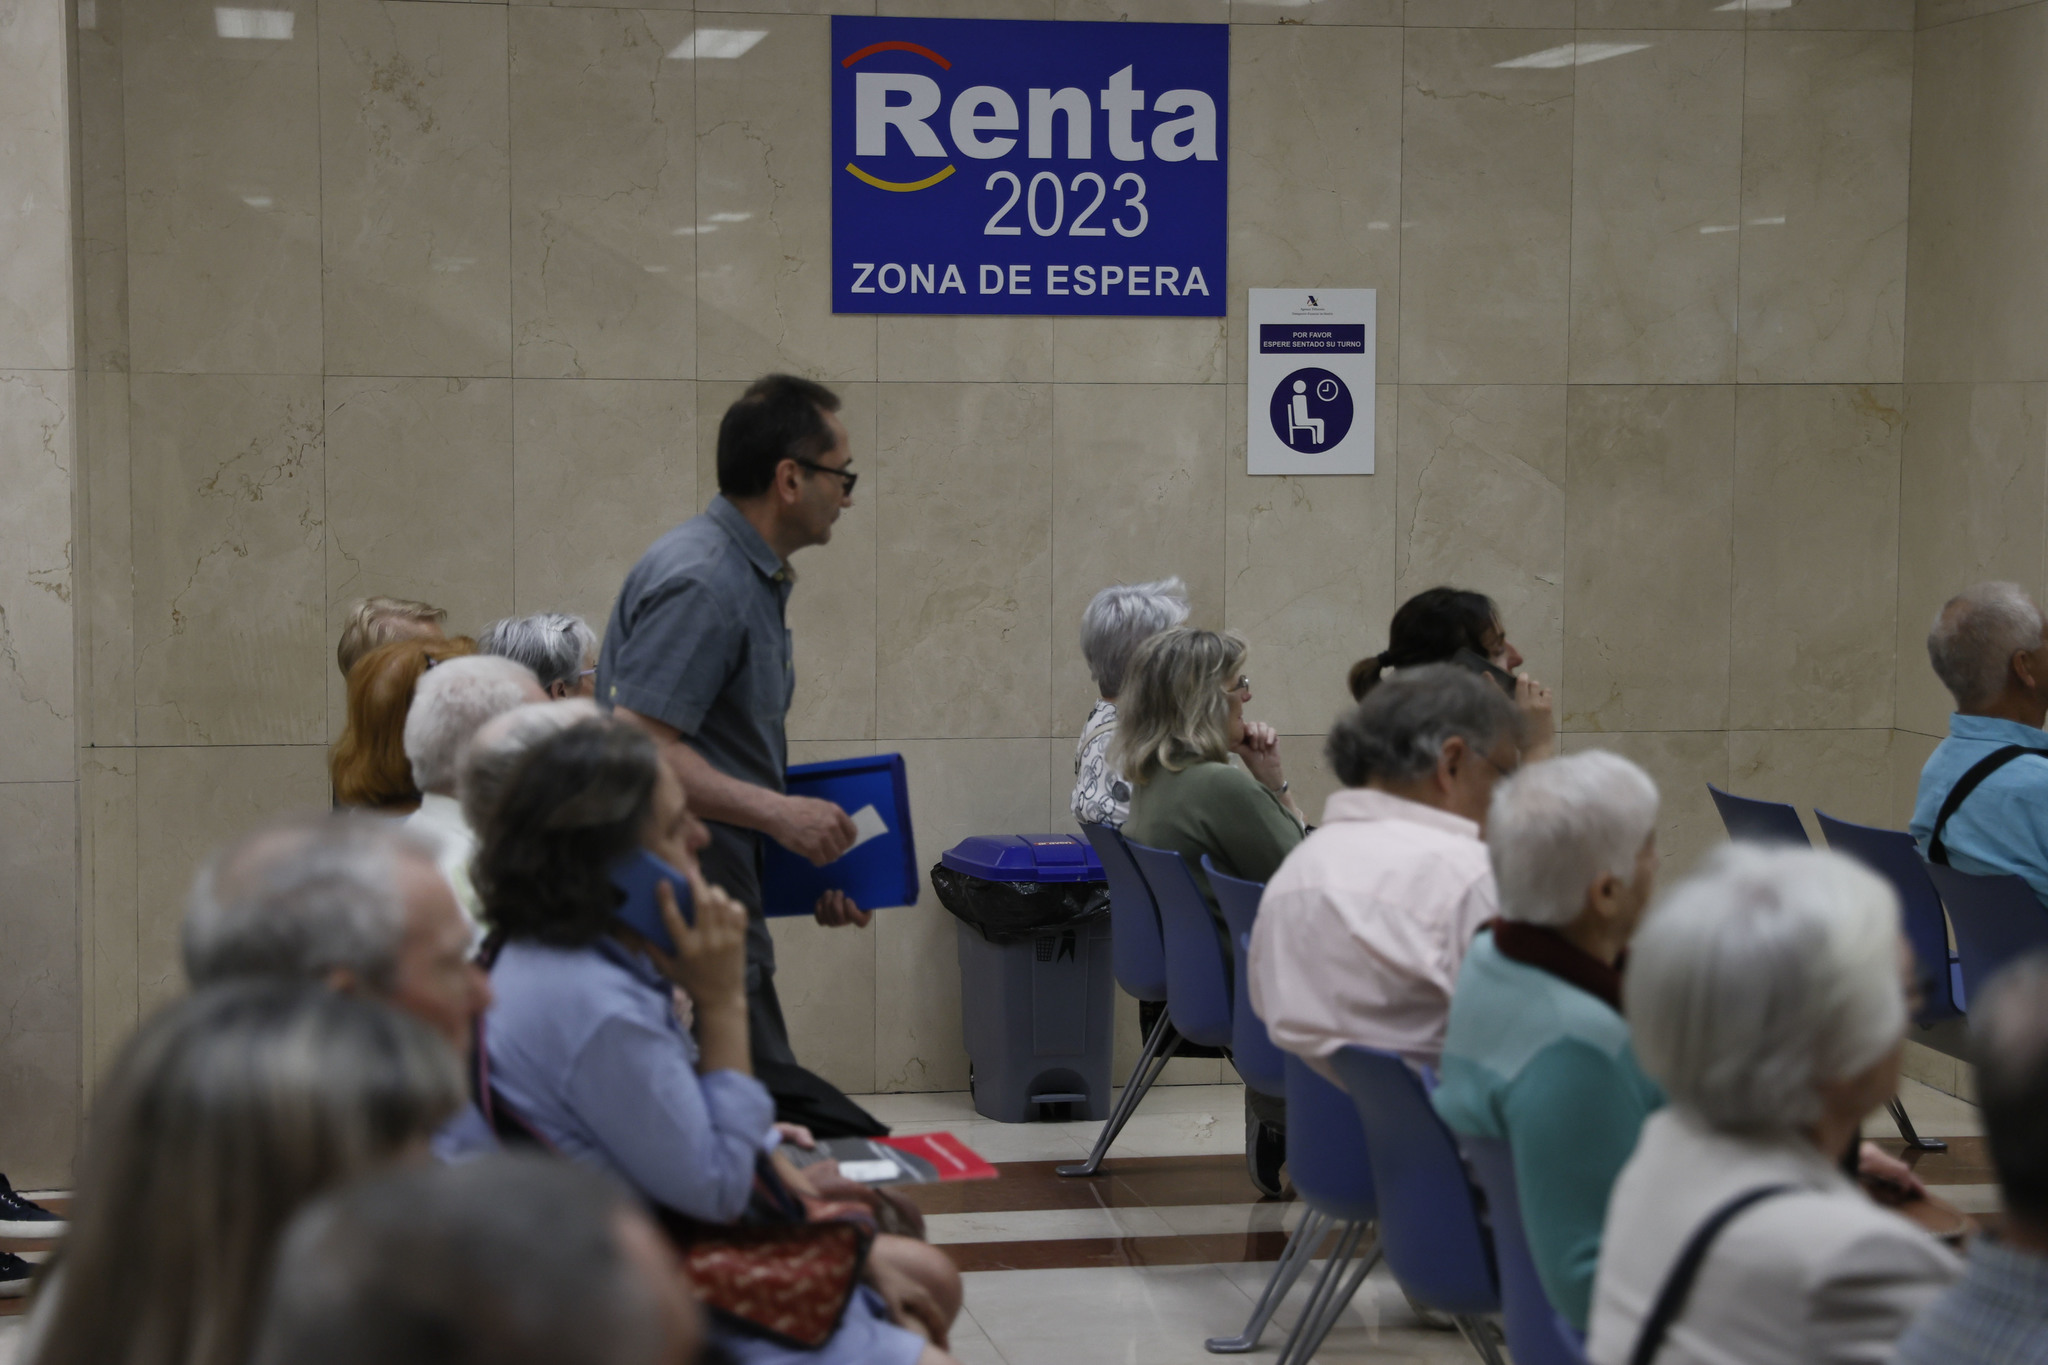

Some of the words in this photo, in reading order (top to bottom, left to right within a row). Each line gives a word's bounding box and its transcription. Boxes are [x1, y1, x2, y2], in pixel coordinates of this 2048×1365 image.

[855, 63, 1219, 162] Renta
[983, 170, 1149, 238] 2023
[850, 262, 967, 295] ZONA
[978, 264, 1032, 296] DE
[1046, 264, 1210, 297] ESPERA
